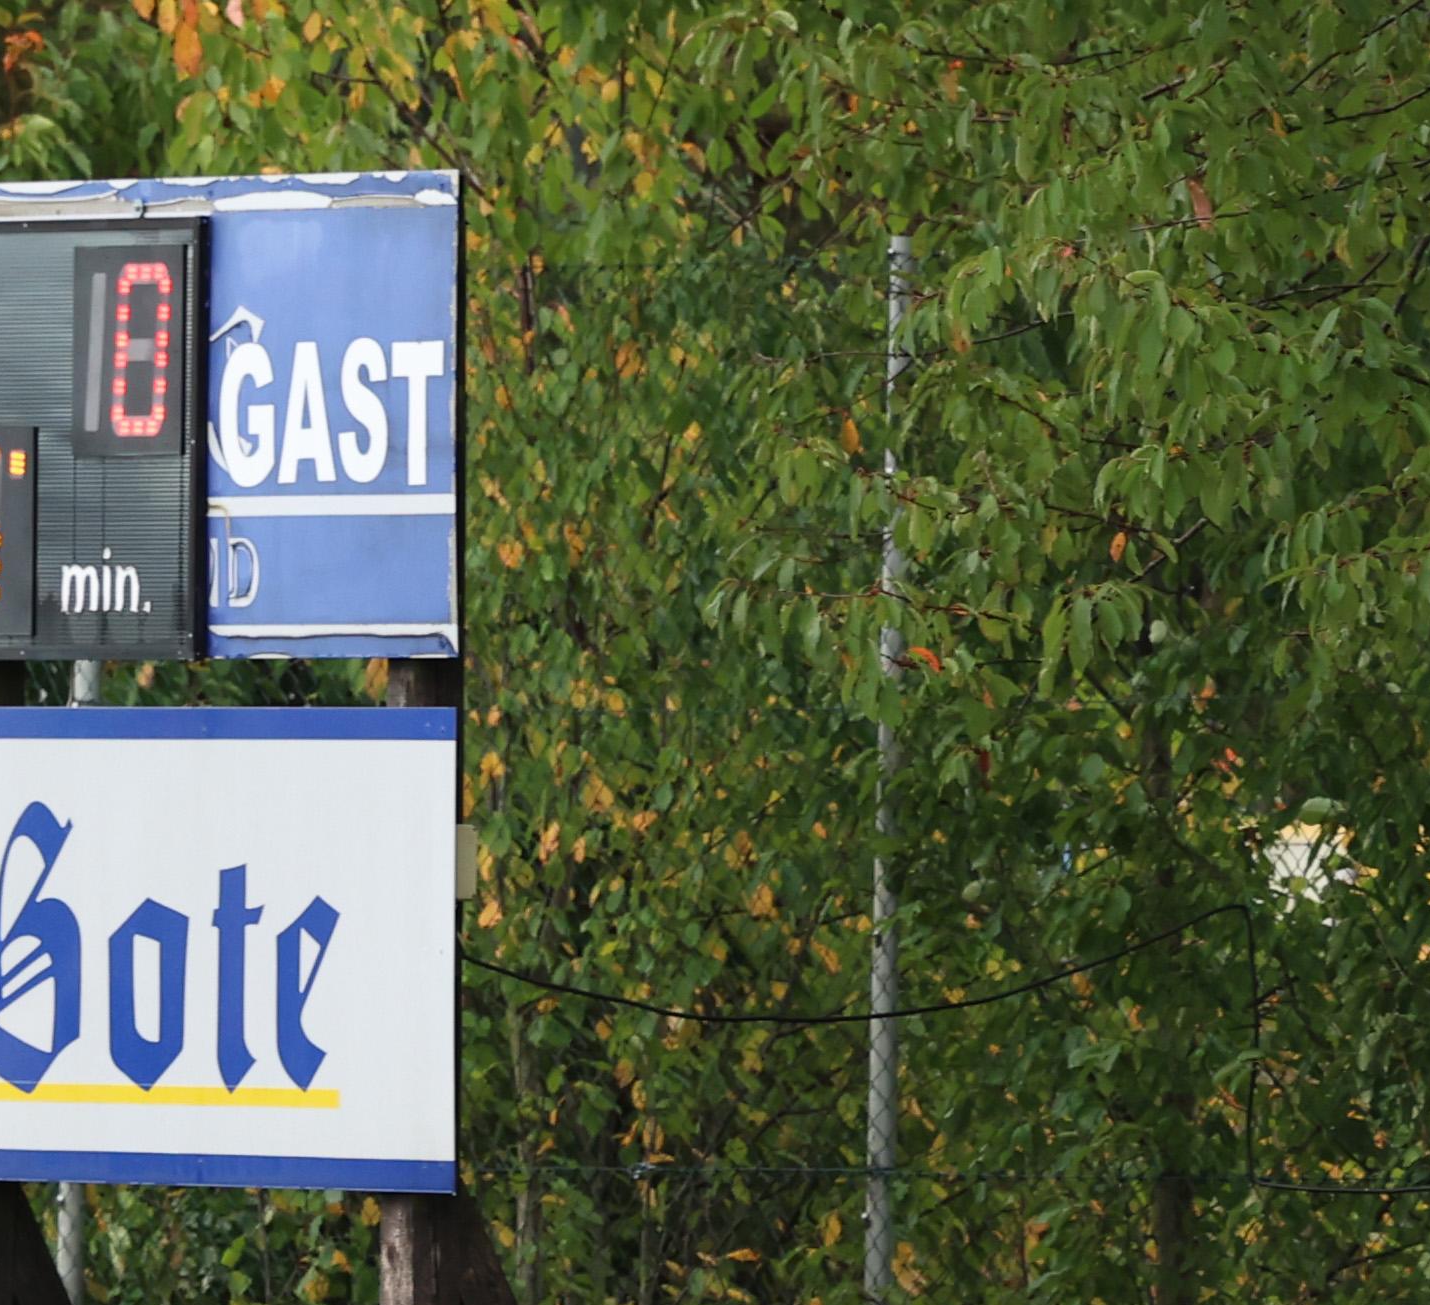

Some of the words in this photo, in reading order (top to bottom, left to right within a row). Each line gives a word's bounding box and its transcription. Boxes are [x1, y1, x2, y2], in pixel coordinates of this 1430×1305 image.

[111, 262, 172, 437] 0
[220, 337, 444, 488] GAST
[60, 547, 152, 613] min.
